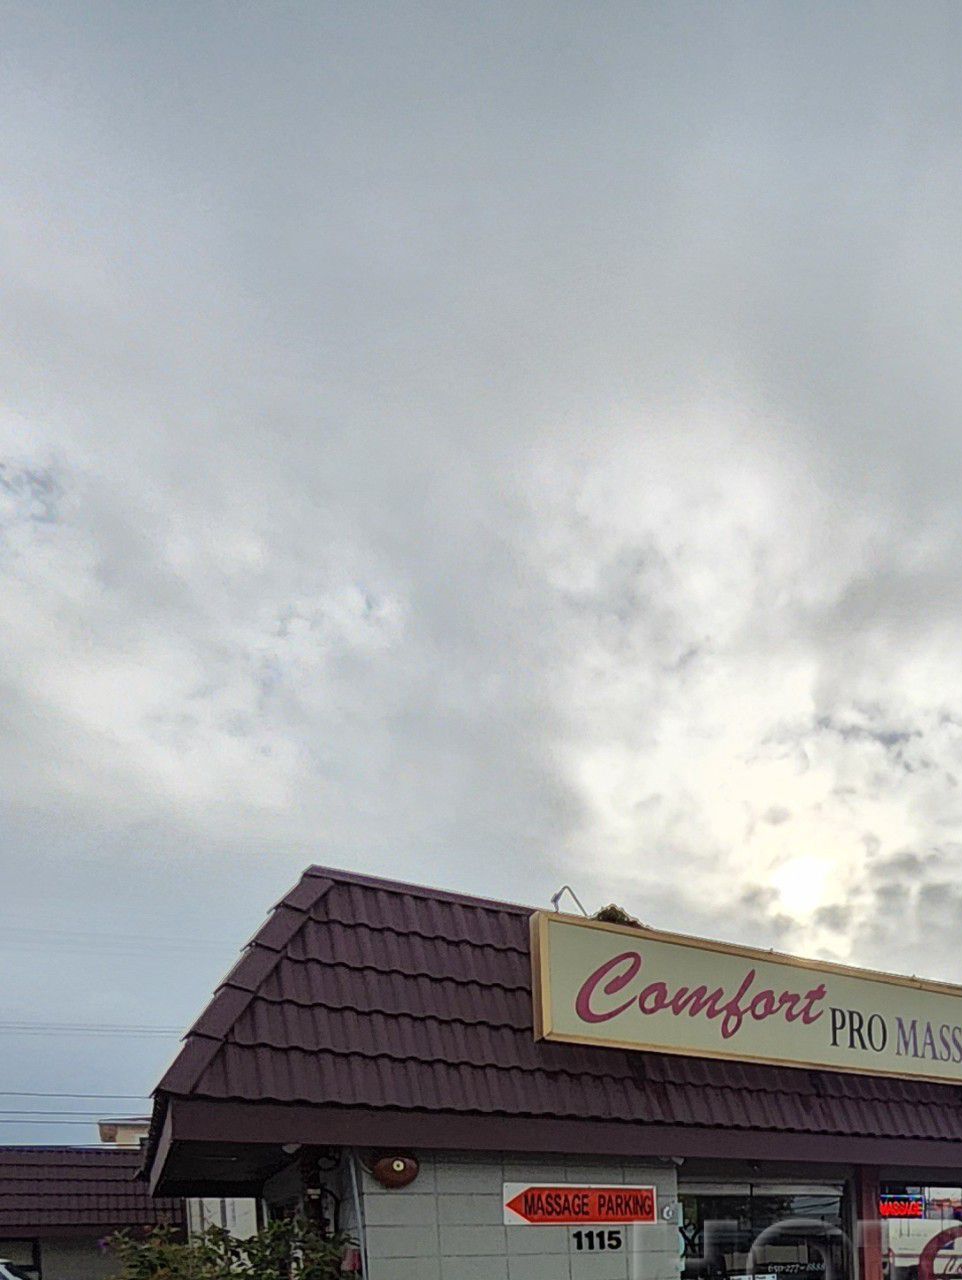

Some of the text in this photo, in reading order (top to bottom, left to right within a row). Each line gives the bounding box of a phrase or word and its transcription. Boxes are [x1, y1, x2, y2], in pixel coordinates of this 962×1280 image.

[575, 951, 827, 1040] Comfort
[830, 1006, 888, 1053] PRO
[522, 1193, 653, 1216] MASSAGE PARKING
[572, 1229, 622, 1251] 1115
